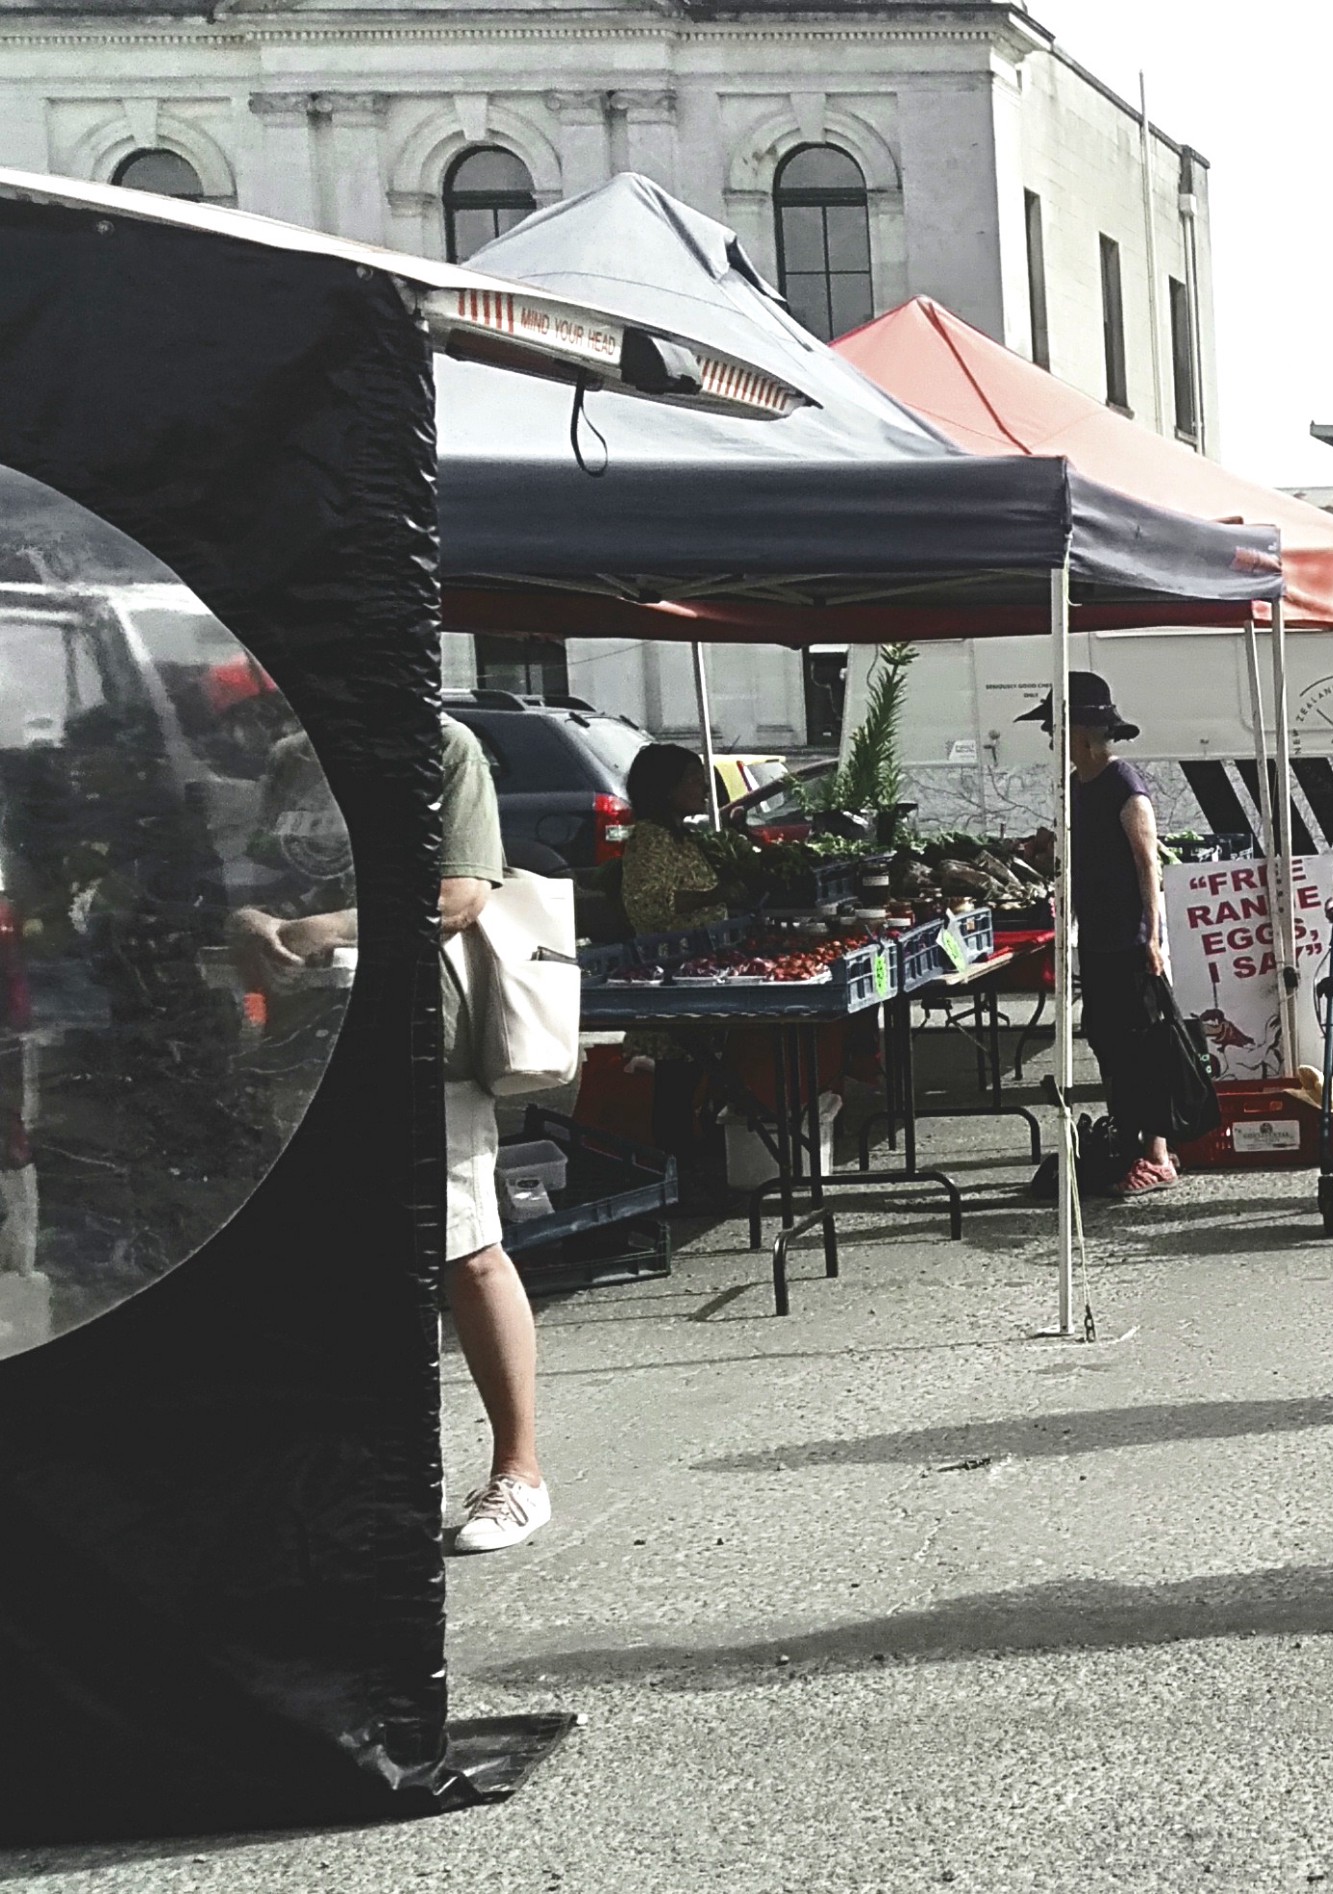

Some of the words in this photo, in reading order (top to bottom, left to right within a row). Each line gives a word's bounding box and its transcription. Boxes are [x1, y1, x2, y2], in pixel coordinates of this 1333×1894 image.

[521, 307, 550, 335] MIND
[554, 316, 584, 345] YOUR
[587, 328, 616, 355] HEAD
[1292, 727, 1303, 755] NEW
[1186, 885, 1322, 929] RANE
[1208, 961, 1221, 984] I
